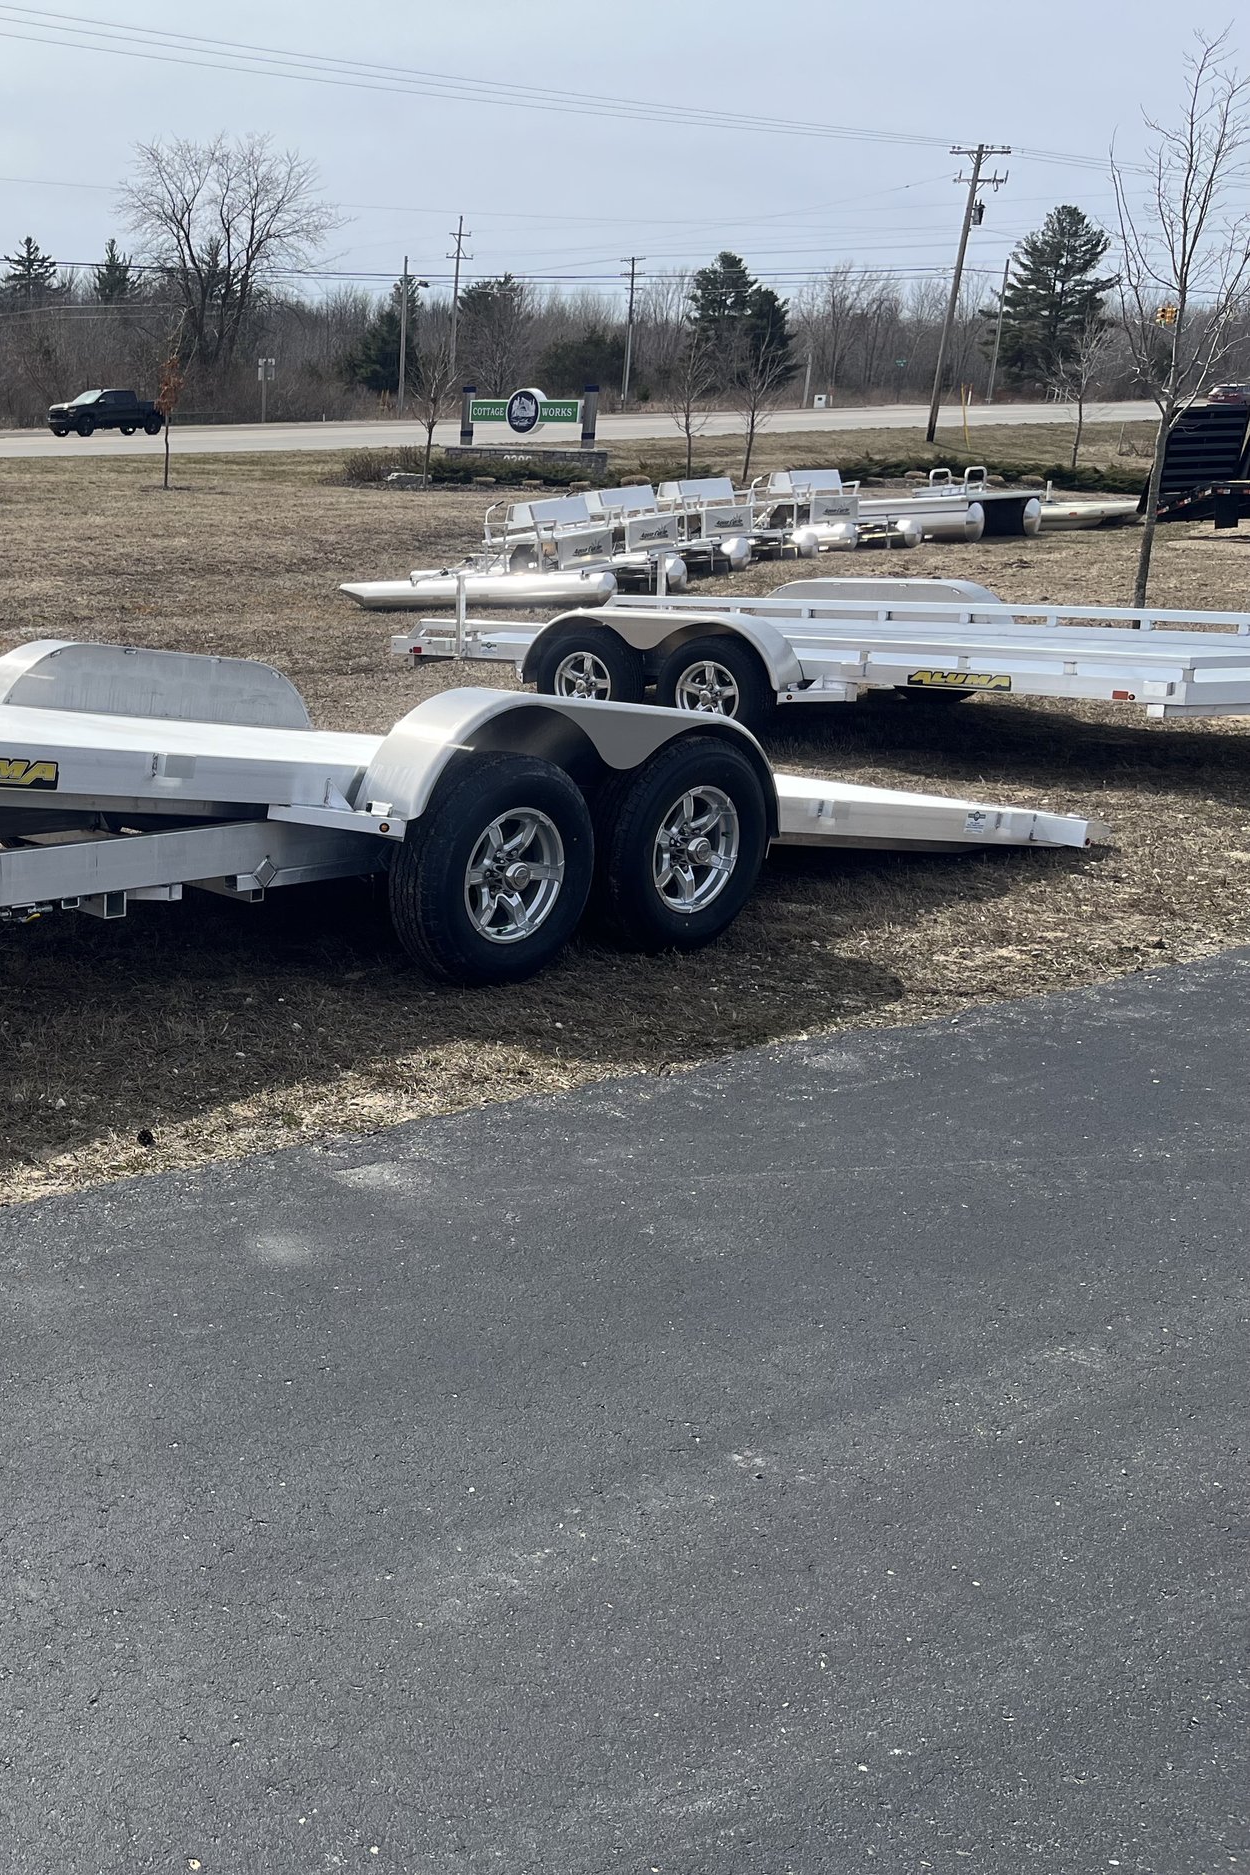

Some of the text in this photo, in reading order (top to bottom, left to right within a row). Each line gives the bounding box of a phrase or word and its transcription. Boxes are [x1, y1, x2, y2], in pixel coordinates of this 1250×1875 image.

[472, 407, 572, 417] COTTAGE WORKS
[909, 671, 1010, 689] ALUMA
